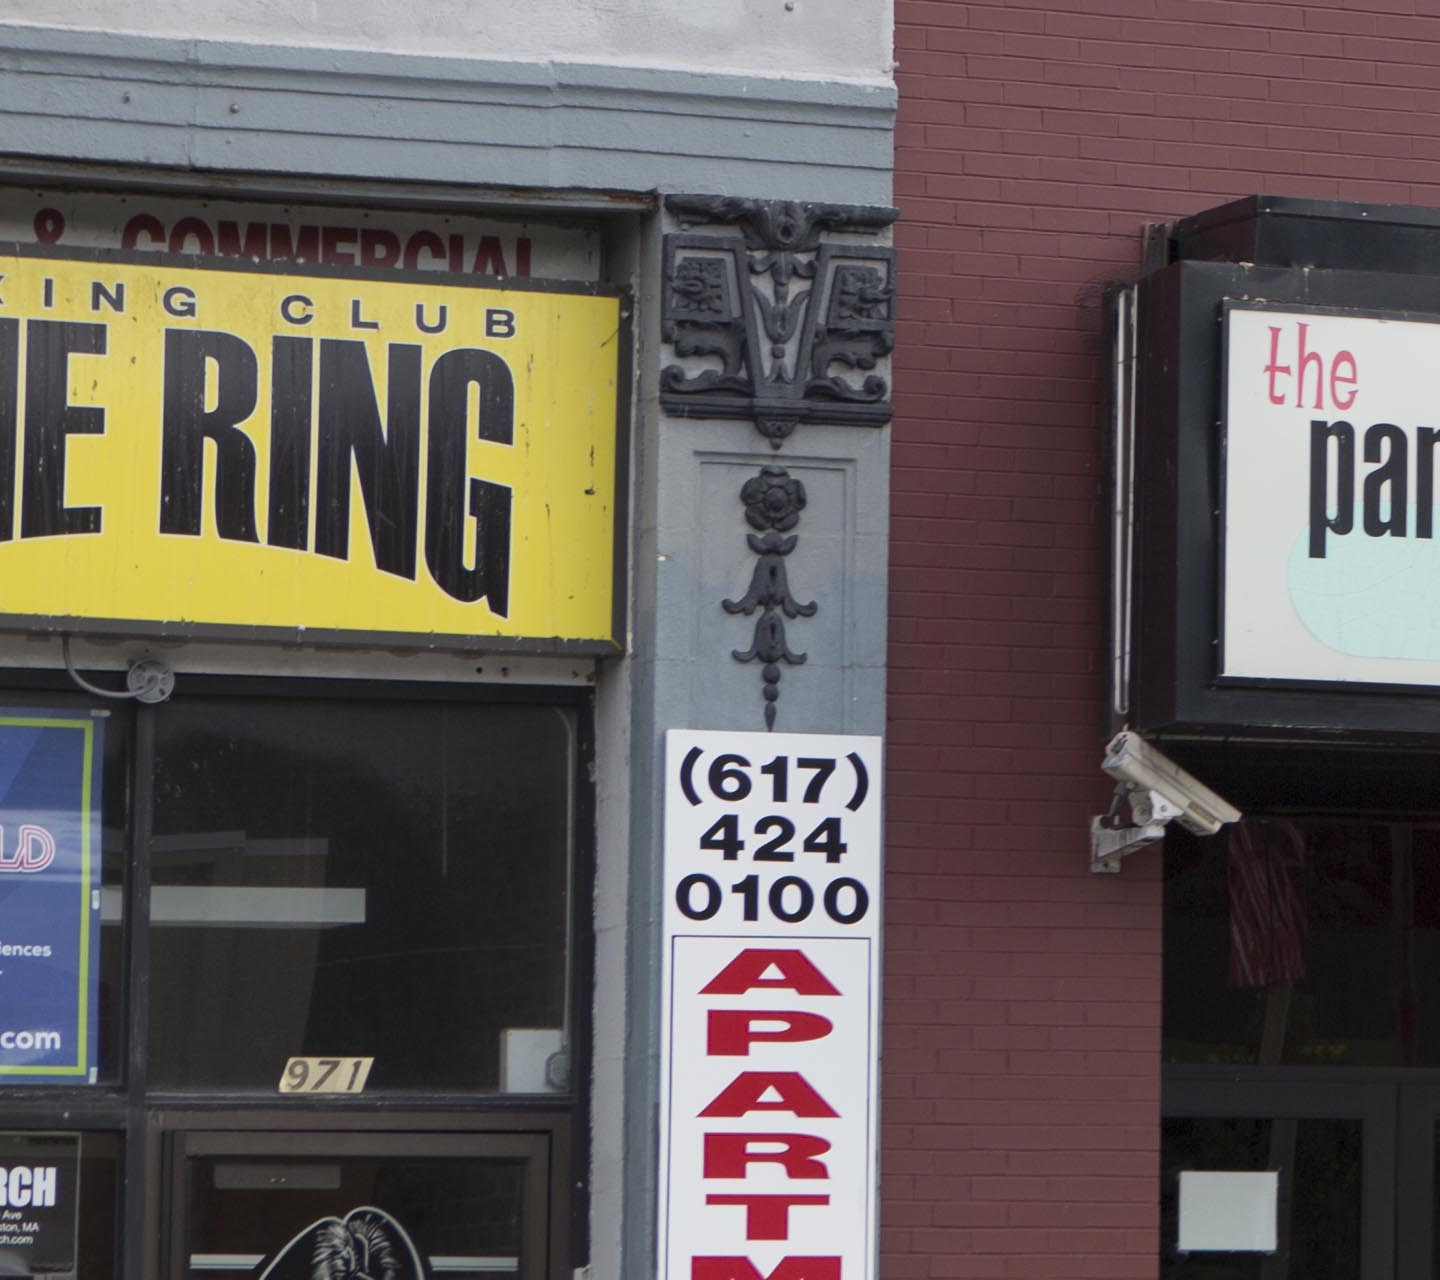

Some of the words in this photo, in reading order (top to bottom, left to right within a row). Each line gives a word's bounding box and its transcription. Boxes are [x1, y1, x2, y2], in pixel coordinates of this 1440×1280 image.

[0, 274, 196, 318] ING
[280, 294, 517, 338] CLUB
[1263, 322, 1359, 411] the
[158, 326, 515, 620] RING
[680, 745, 869, 811] (617)
[699, 815, 848, 864] 424
[675, 873, 870, 924] 0100
[288, 1060, 366, 1092] 971
